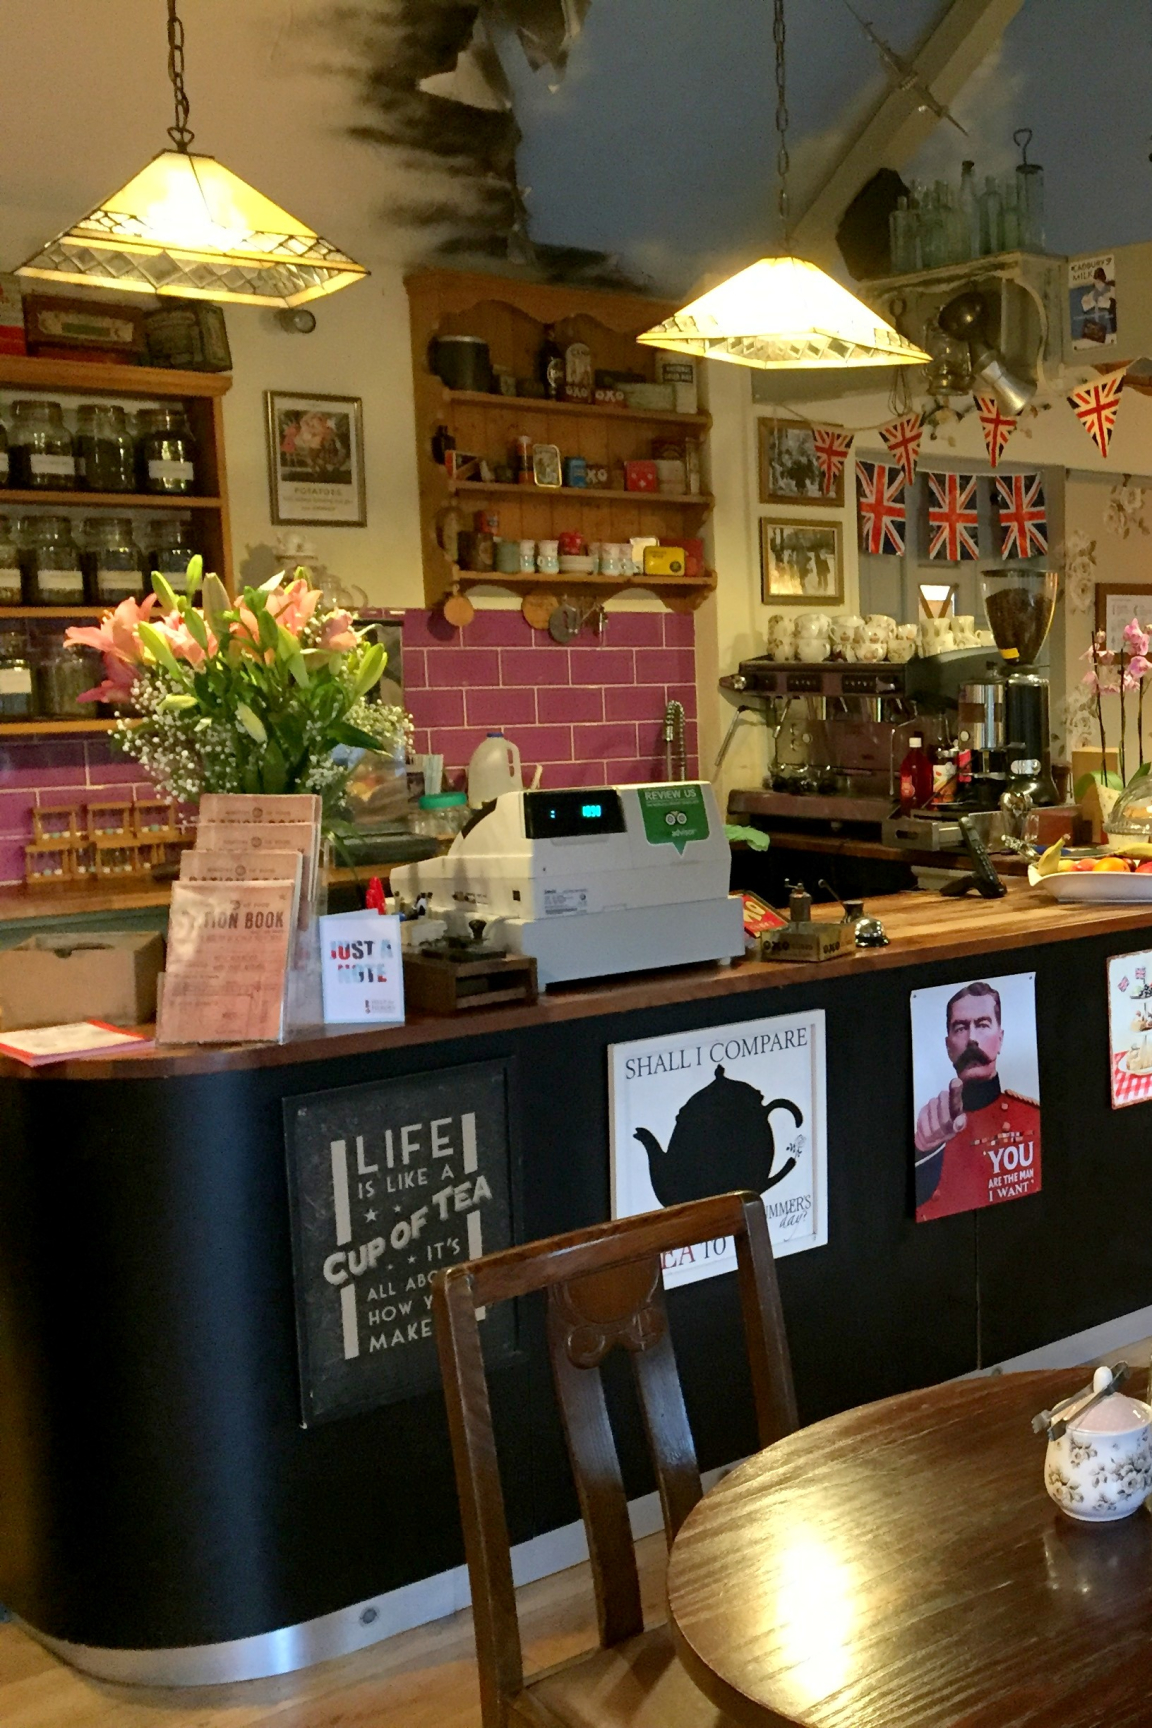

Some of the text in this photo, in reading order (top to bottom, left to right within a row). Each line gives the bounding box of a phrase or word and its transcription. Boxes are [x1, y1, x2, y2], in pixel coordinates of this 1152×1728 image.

[1073, 270, 1094, 281] MILK
[565, 385, 589, 398] OXO
[595, 389, 625, 402] OXO
[586, 467, 608, 483] XO
[294, 487, 343, 496] POTATOES
[645, 788, 697, 801] REVIEW US
[244, 911, 284, 930] BOOK
[743, 900, 766, 923] XO
[330, 939, 394, 960] JUST A
[763, 940, 790, 951] OXO
[823, 941, 841, 954] OXO
[338, 964, 387, 983] NOTE
[625, 1027, 808, 1080] SHALL I COMPARE
[356, 1116, 454, 1176] LIFE
[358, 1163, 454, 1199] IS LIKE A
[988, 1168, 1034, 1189] ARE THE MAN
[989, 1190, 994, 1202] I
[323, 1174, 493, 1286] CUP OF TEA
[427, 1237, 461, 1262] IT'S
[661, 1236, 727, 1270] EA TO
[367, 1282, 396, 1302] ALL
[368, 1300, 413, 1326] HOW
[369, 1319, 433, 1353] MAKE
